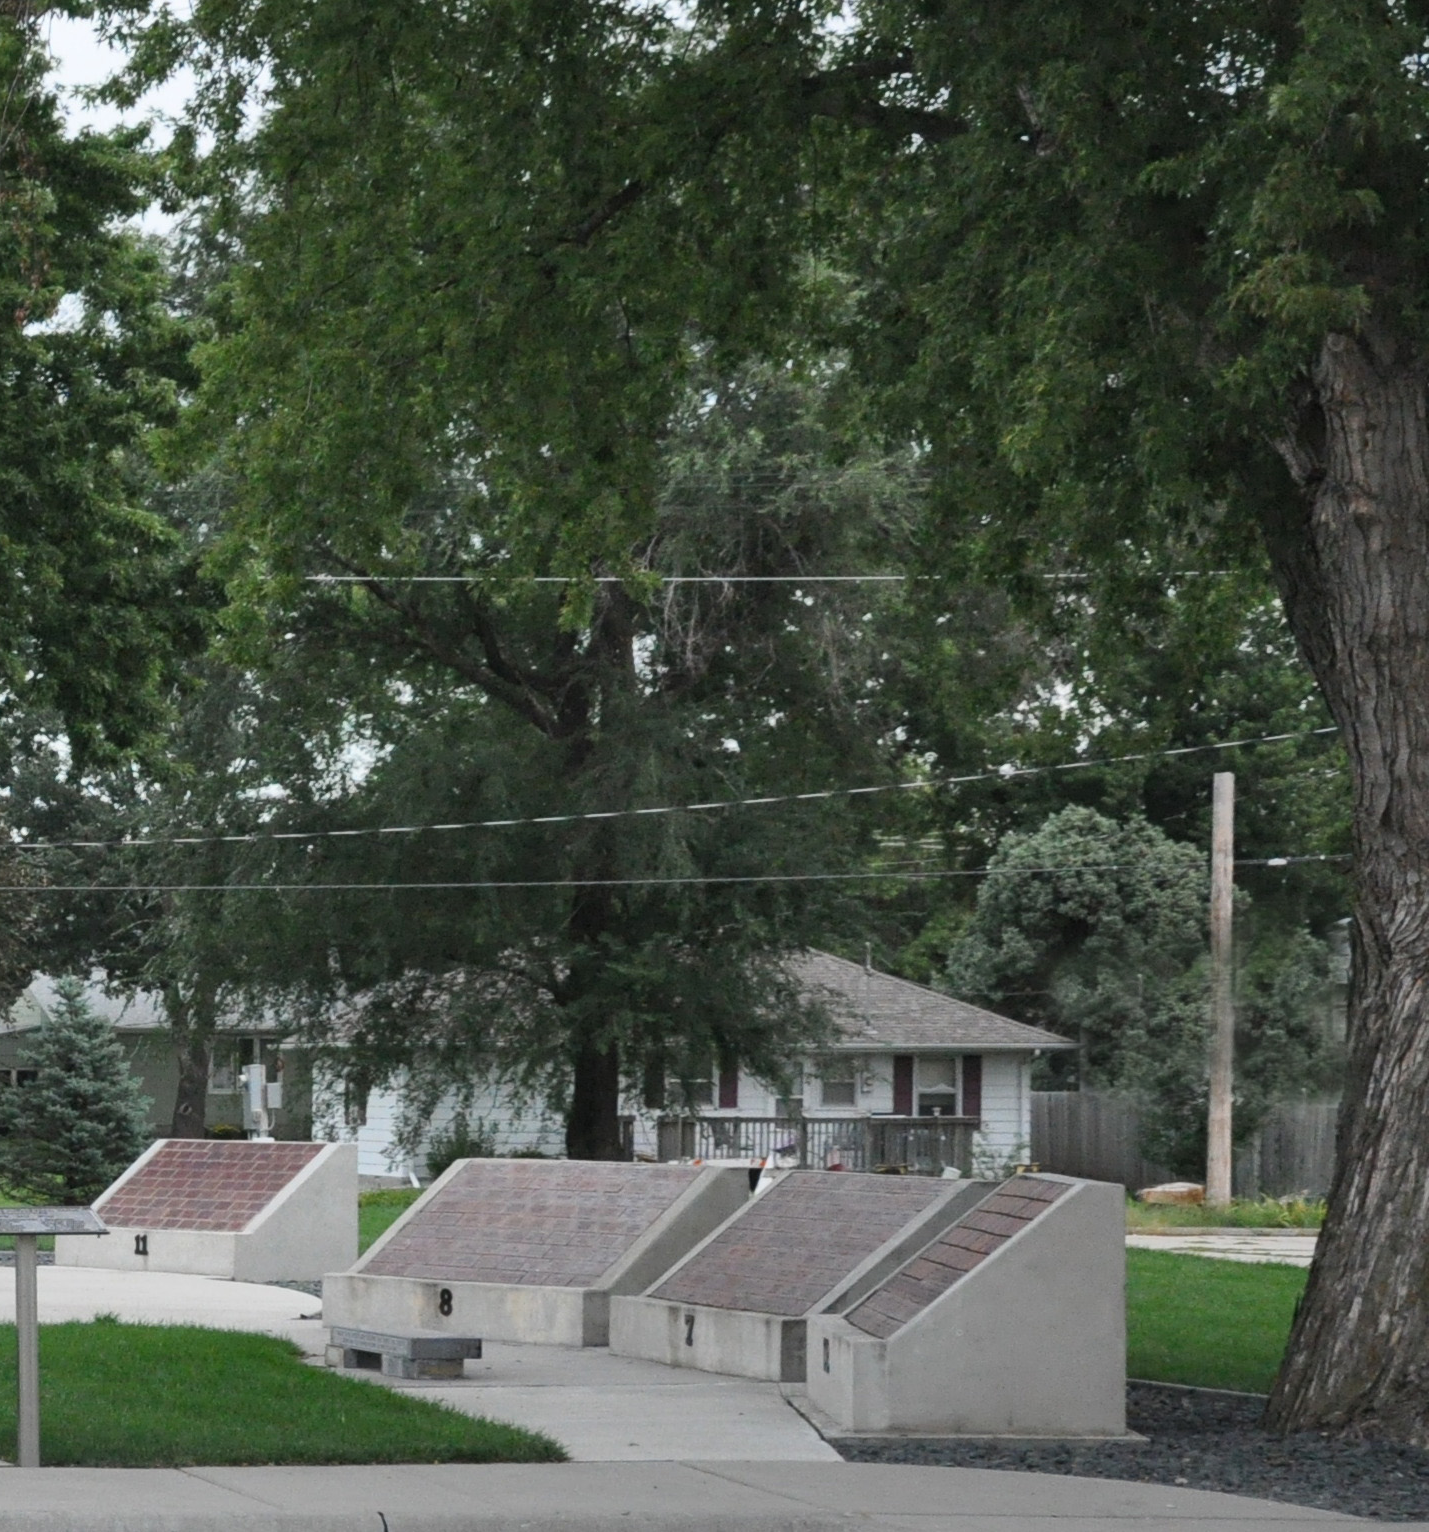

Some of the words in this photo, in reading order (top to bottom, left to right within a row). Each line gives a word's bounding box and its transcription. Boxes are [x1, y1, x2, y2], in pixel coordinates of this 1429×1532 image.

[134, 1234, 148, 1256] 11
[438, 1288, 453, 1316] 8
[684, 1313, 695, 1347] 7
